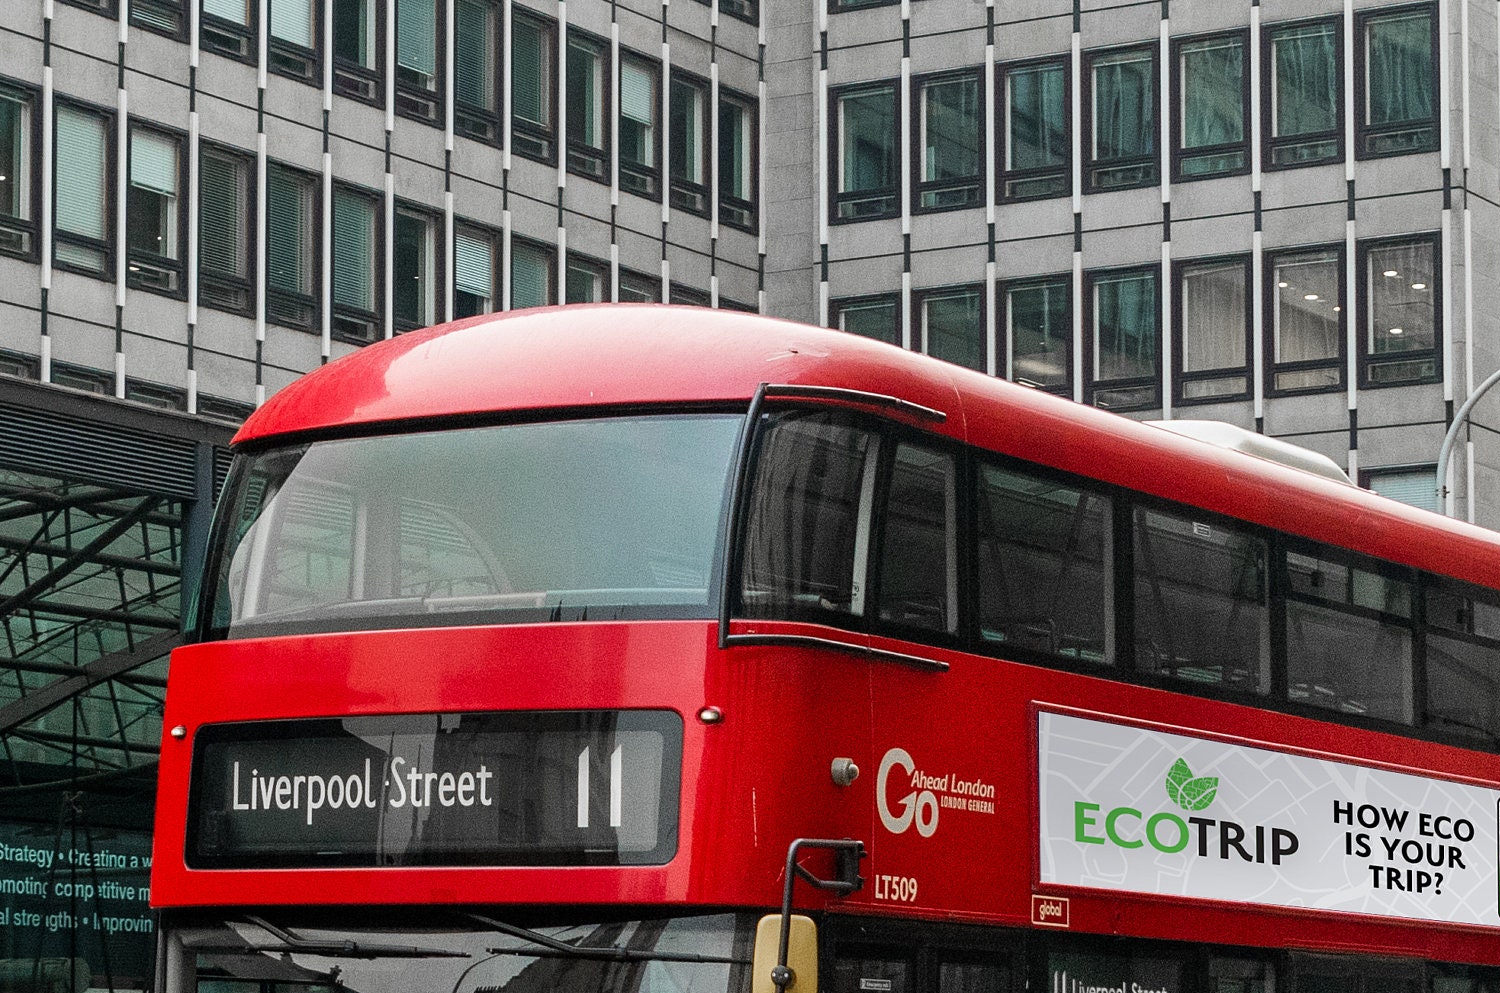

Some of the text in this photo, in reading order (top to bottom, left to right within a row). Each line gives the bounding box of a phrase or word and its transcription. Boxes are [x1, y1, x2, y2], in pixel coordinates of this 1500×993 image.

[232, 756, 493, 825] Liverpool Street
[577, 743, 622, 828] 11
[877, 748, 939, 838] Go
[911, 770, 995, 798] Ahead London
[941, 795, 995, 814] LONDON GENERAL
[1073, 800, 1300, 866] ECOTRIP
[1333, 800, 1476, 843] HOW ECO
[130, 855, 138, 867] a
[1345, 831, 1467, 870] IS YOUR
[0, 877, 49, 899] moting
[875, 874, 918, 902] LT509
[1368, 864, 1445, 896] TRIP?
[1039, 901, 1062, 921] global
